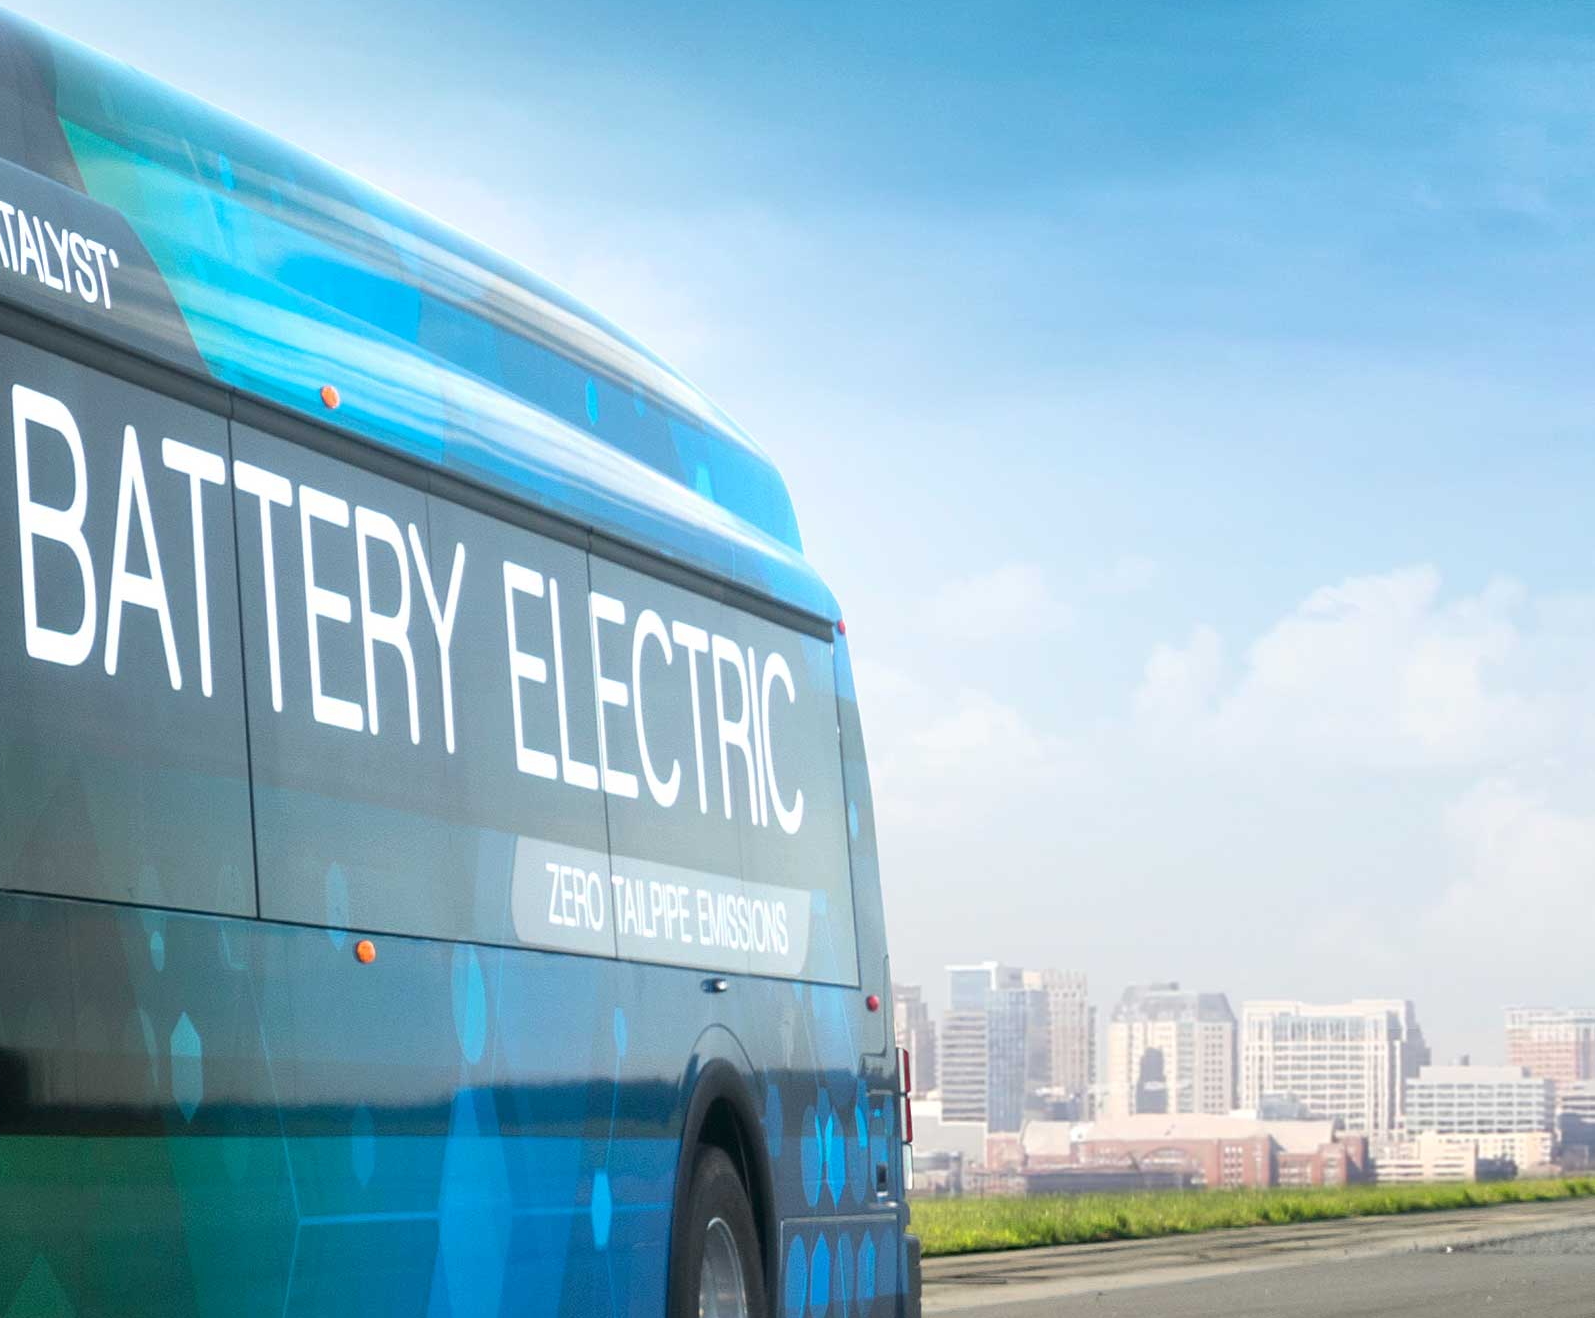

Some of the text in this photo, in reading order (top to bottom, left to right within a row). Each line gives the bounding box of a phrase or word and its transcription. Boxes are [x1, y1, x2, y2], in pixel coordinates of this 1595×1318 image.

[11, 383, 805, 836] BATTERY ELECTRIC
[545, 862, 790, 956] ZERO TAILPIPE EMISSIONS
